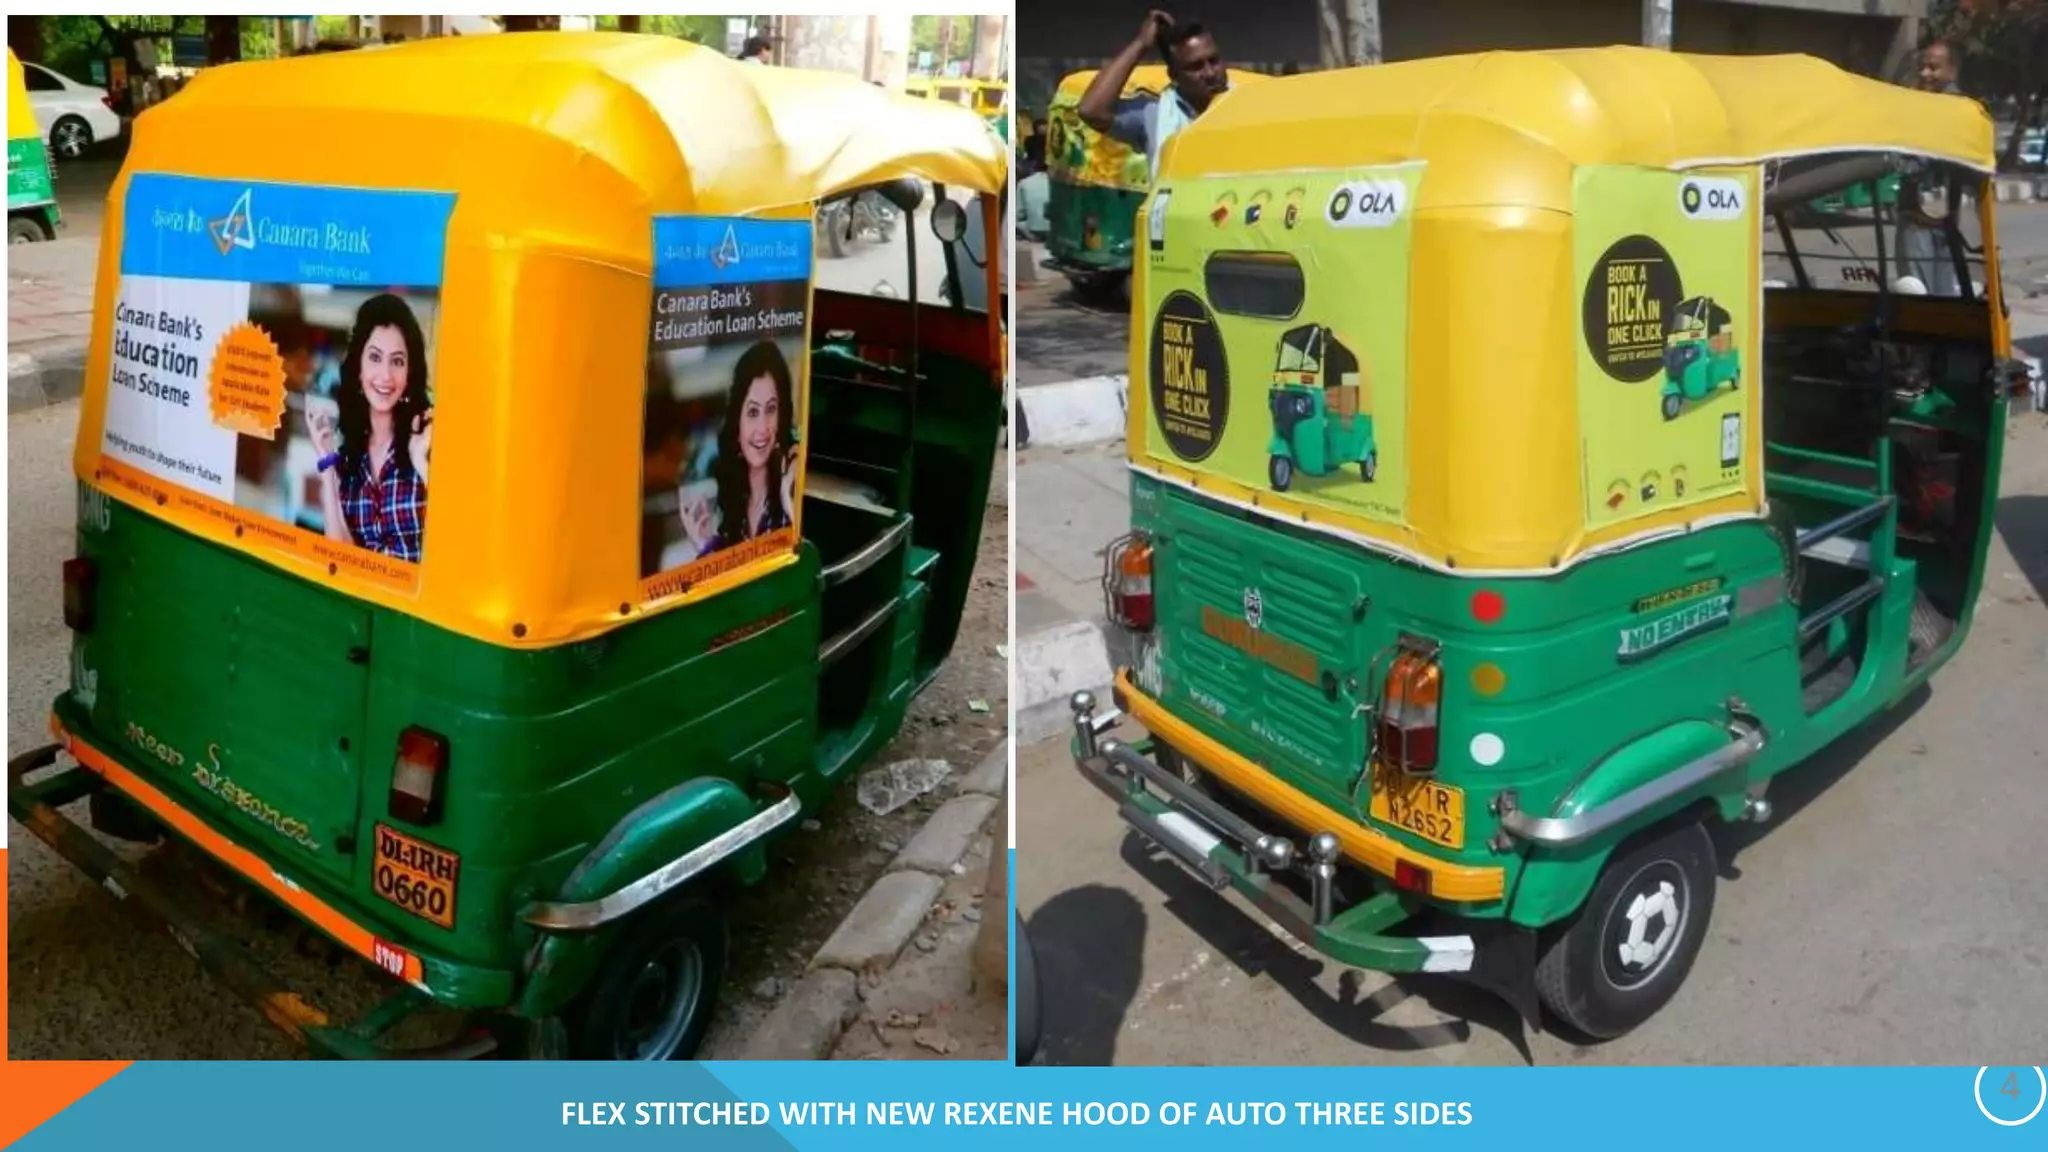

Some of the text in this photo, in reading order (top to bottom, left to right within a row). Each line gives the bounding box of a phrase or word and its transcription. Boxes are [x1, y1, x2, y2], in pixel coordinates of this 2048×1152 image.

[1358, 192, 1396, 214] OLA
[1707, 188, 1740, 209] OLA
[258, 217, 371, 254] Canara Bank
[1608, 264, 1648, 284] BOOK A
[657, 287, 752, 315] Canara Bank's
[1607, 284, 1661, 324] RICK IN
[158, 311, 203, 341] Bank's
[654, 307, 804, 342] Education Loan Scheme
[1185, 324, 1194, 345] A
[1607, 322, 1663, 345] ONE CLICK
[114, 329, 199, 379] Education
[1163, 342, 1194, 392] RICK
[378, 864, 447, 917] 0660
[374, 942, 405, 977] STOP
